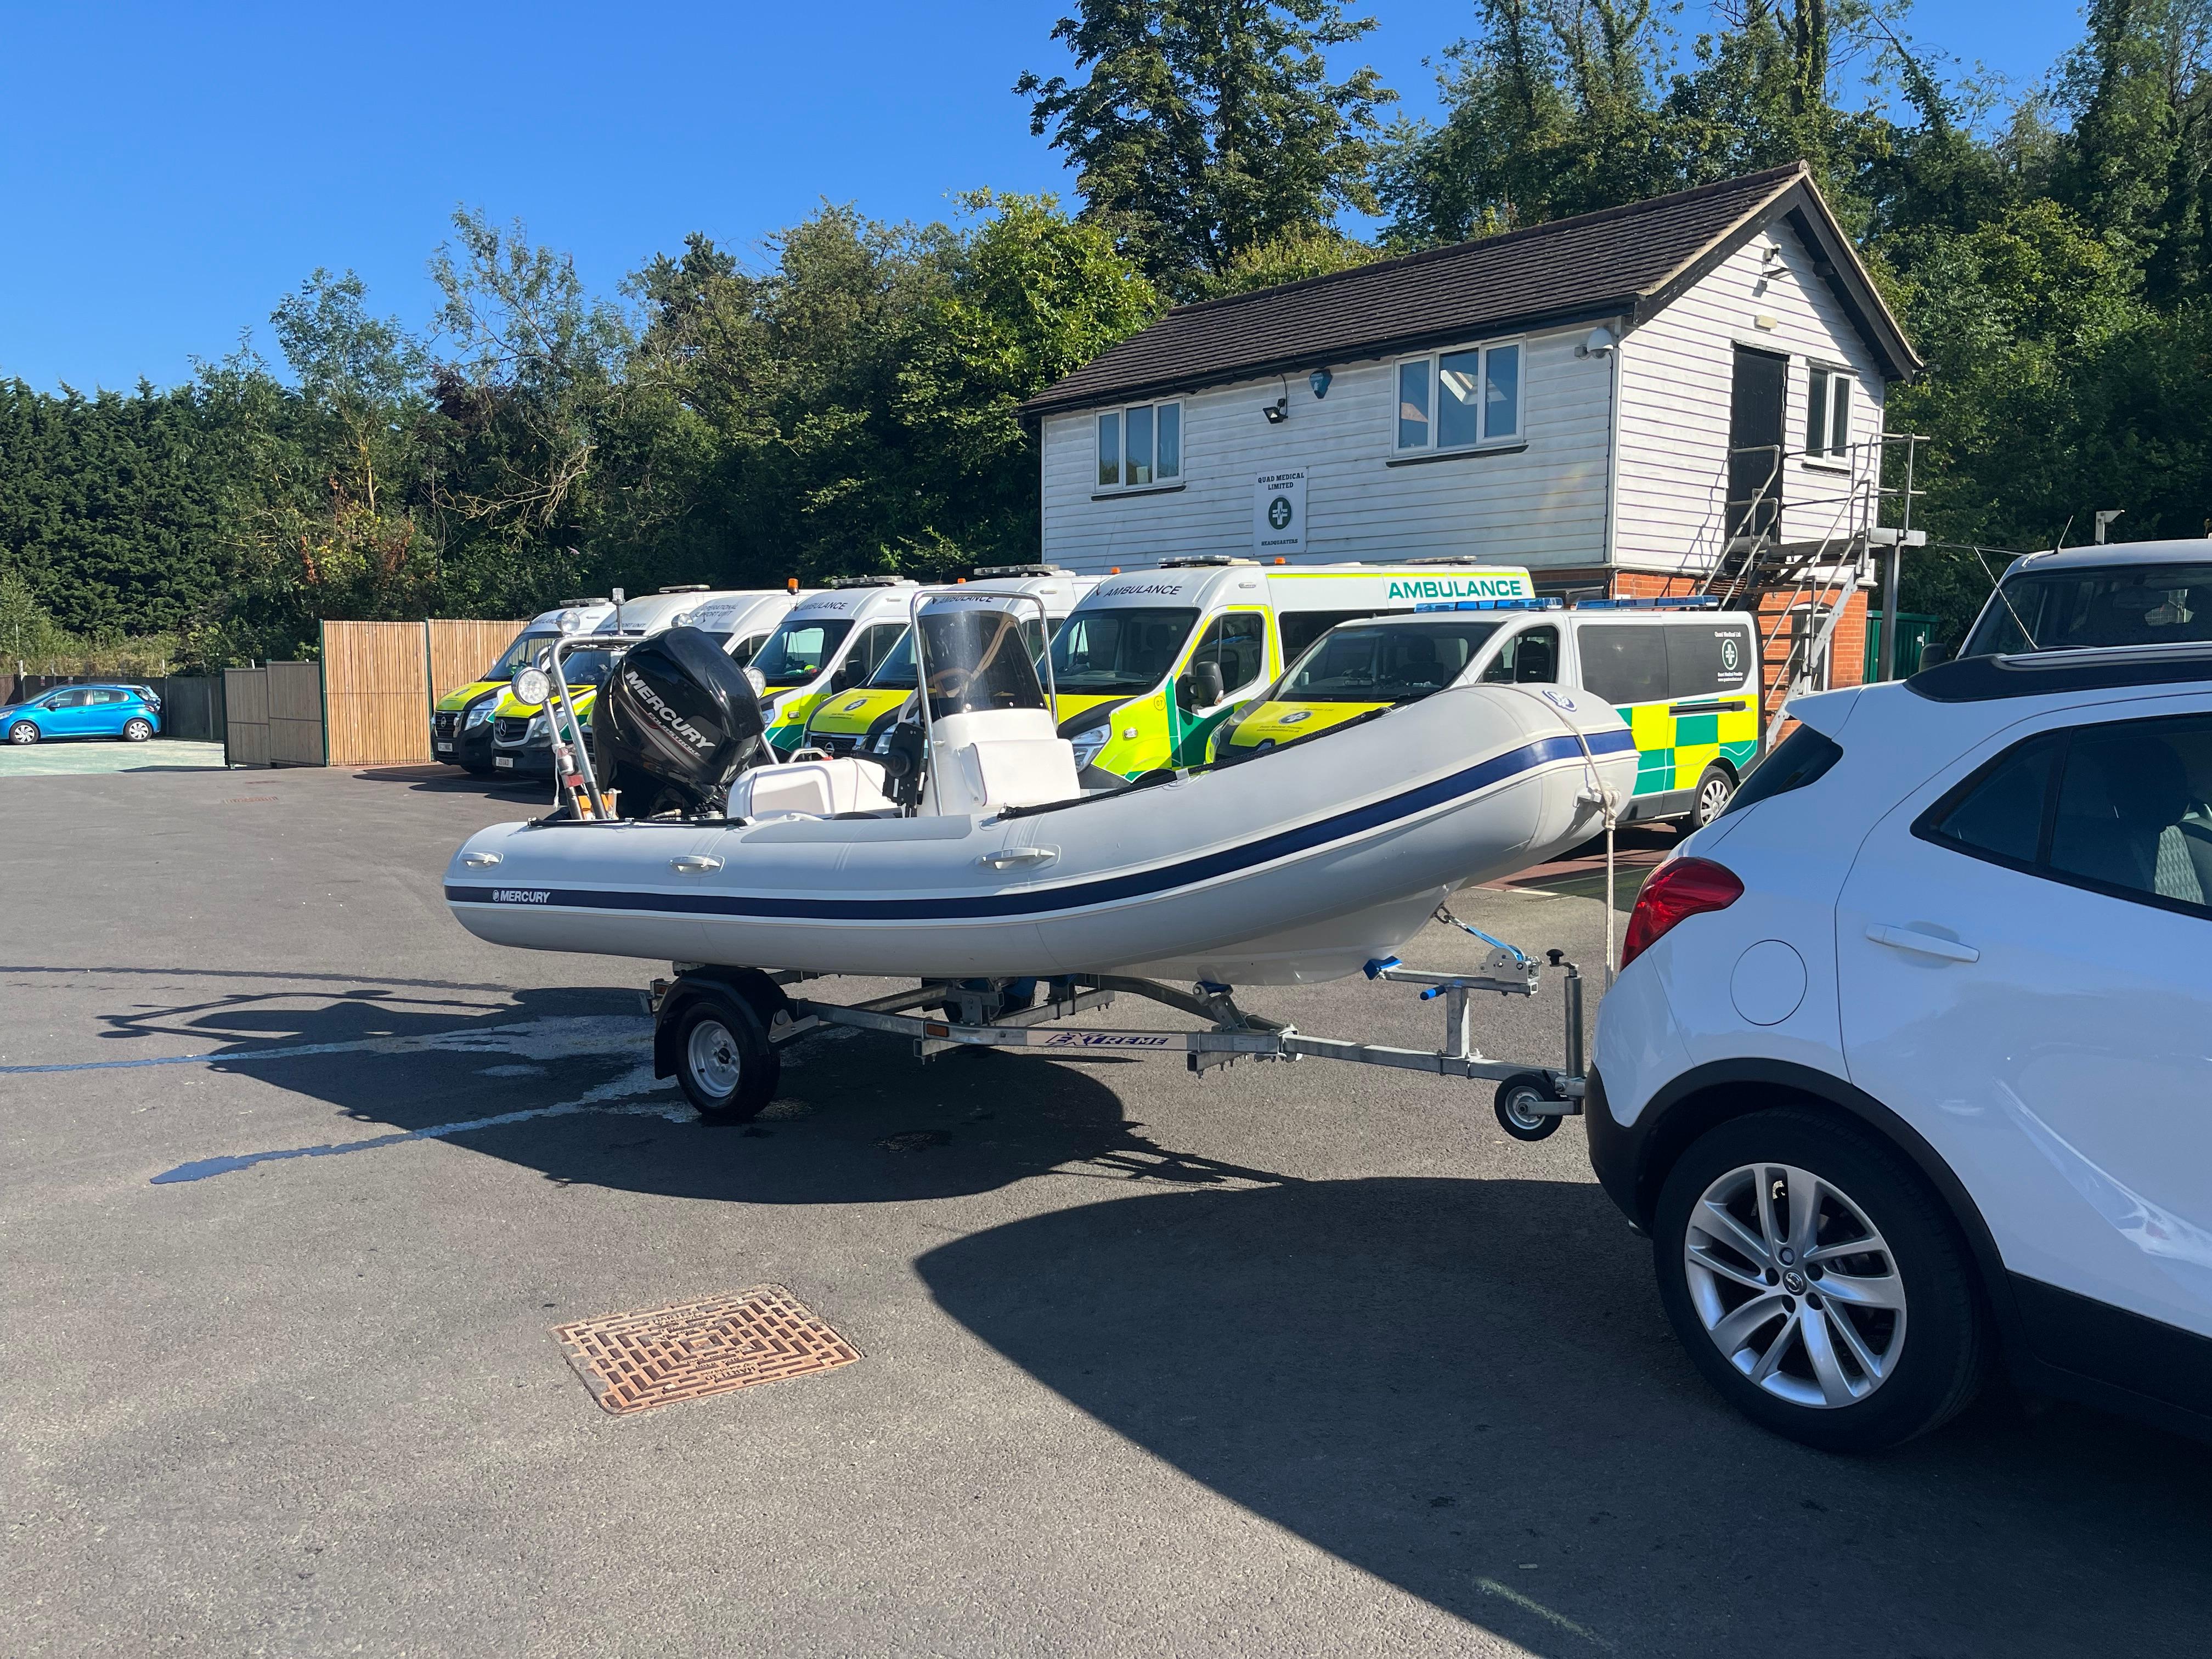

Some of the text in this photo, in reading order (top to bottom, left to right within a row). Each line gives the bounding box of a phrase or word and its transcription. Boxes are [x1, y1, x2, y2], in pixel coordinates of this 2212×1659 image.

[1276, 472, 1305, 481] MEDICAL
[1103, 585, 1182, 597] AMBULANCE
[1389, 580, 1522, 599] AMBULANCE
[625, 671, 715, 748] MERCURY
[647, 712, 701, 757] FOURSTROKE
[500, 890, 550, 903] MERCURY
[1045, 1032, 1170, 1046] EXTREME
